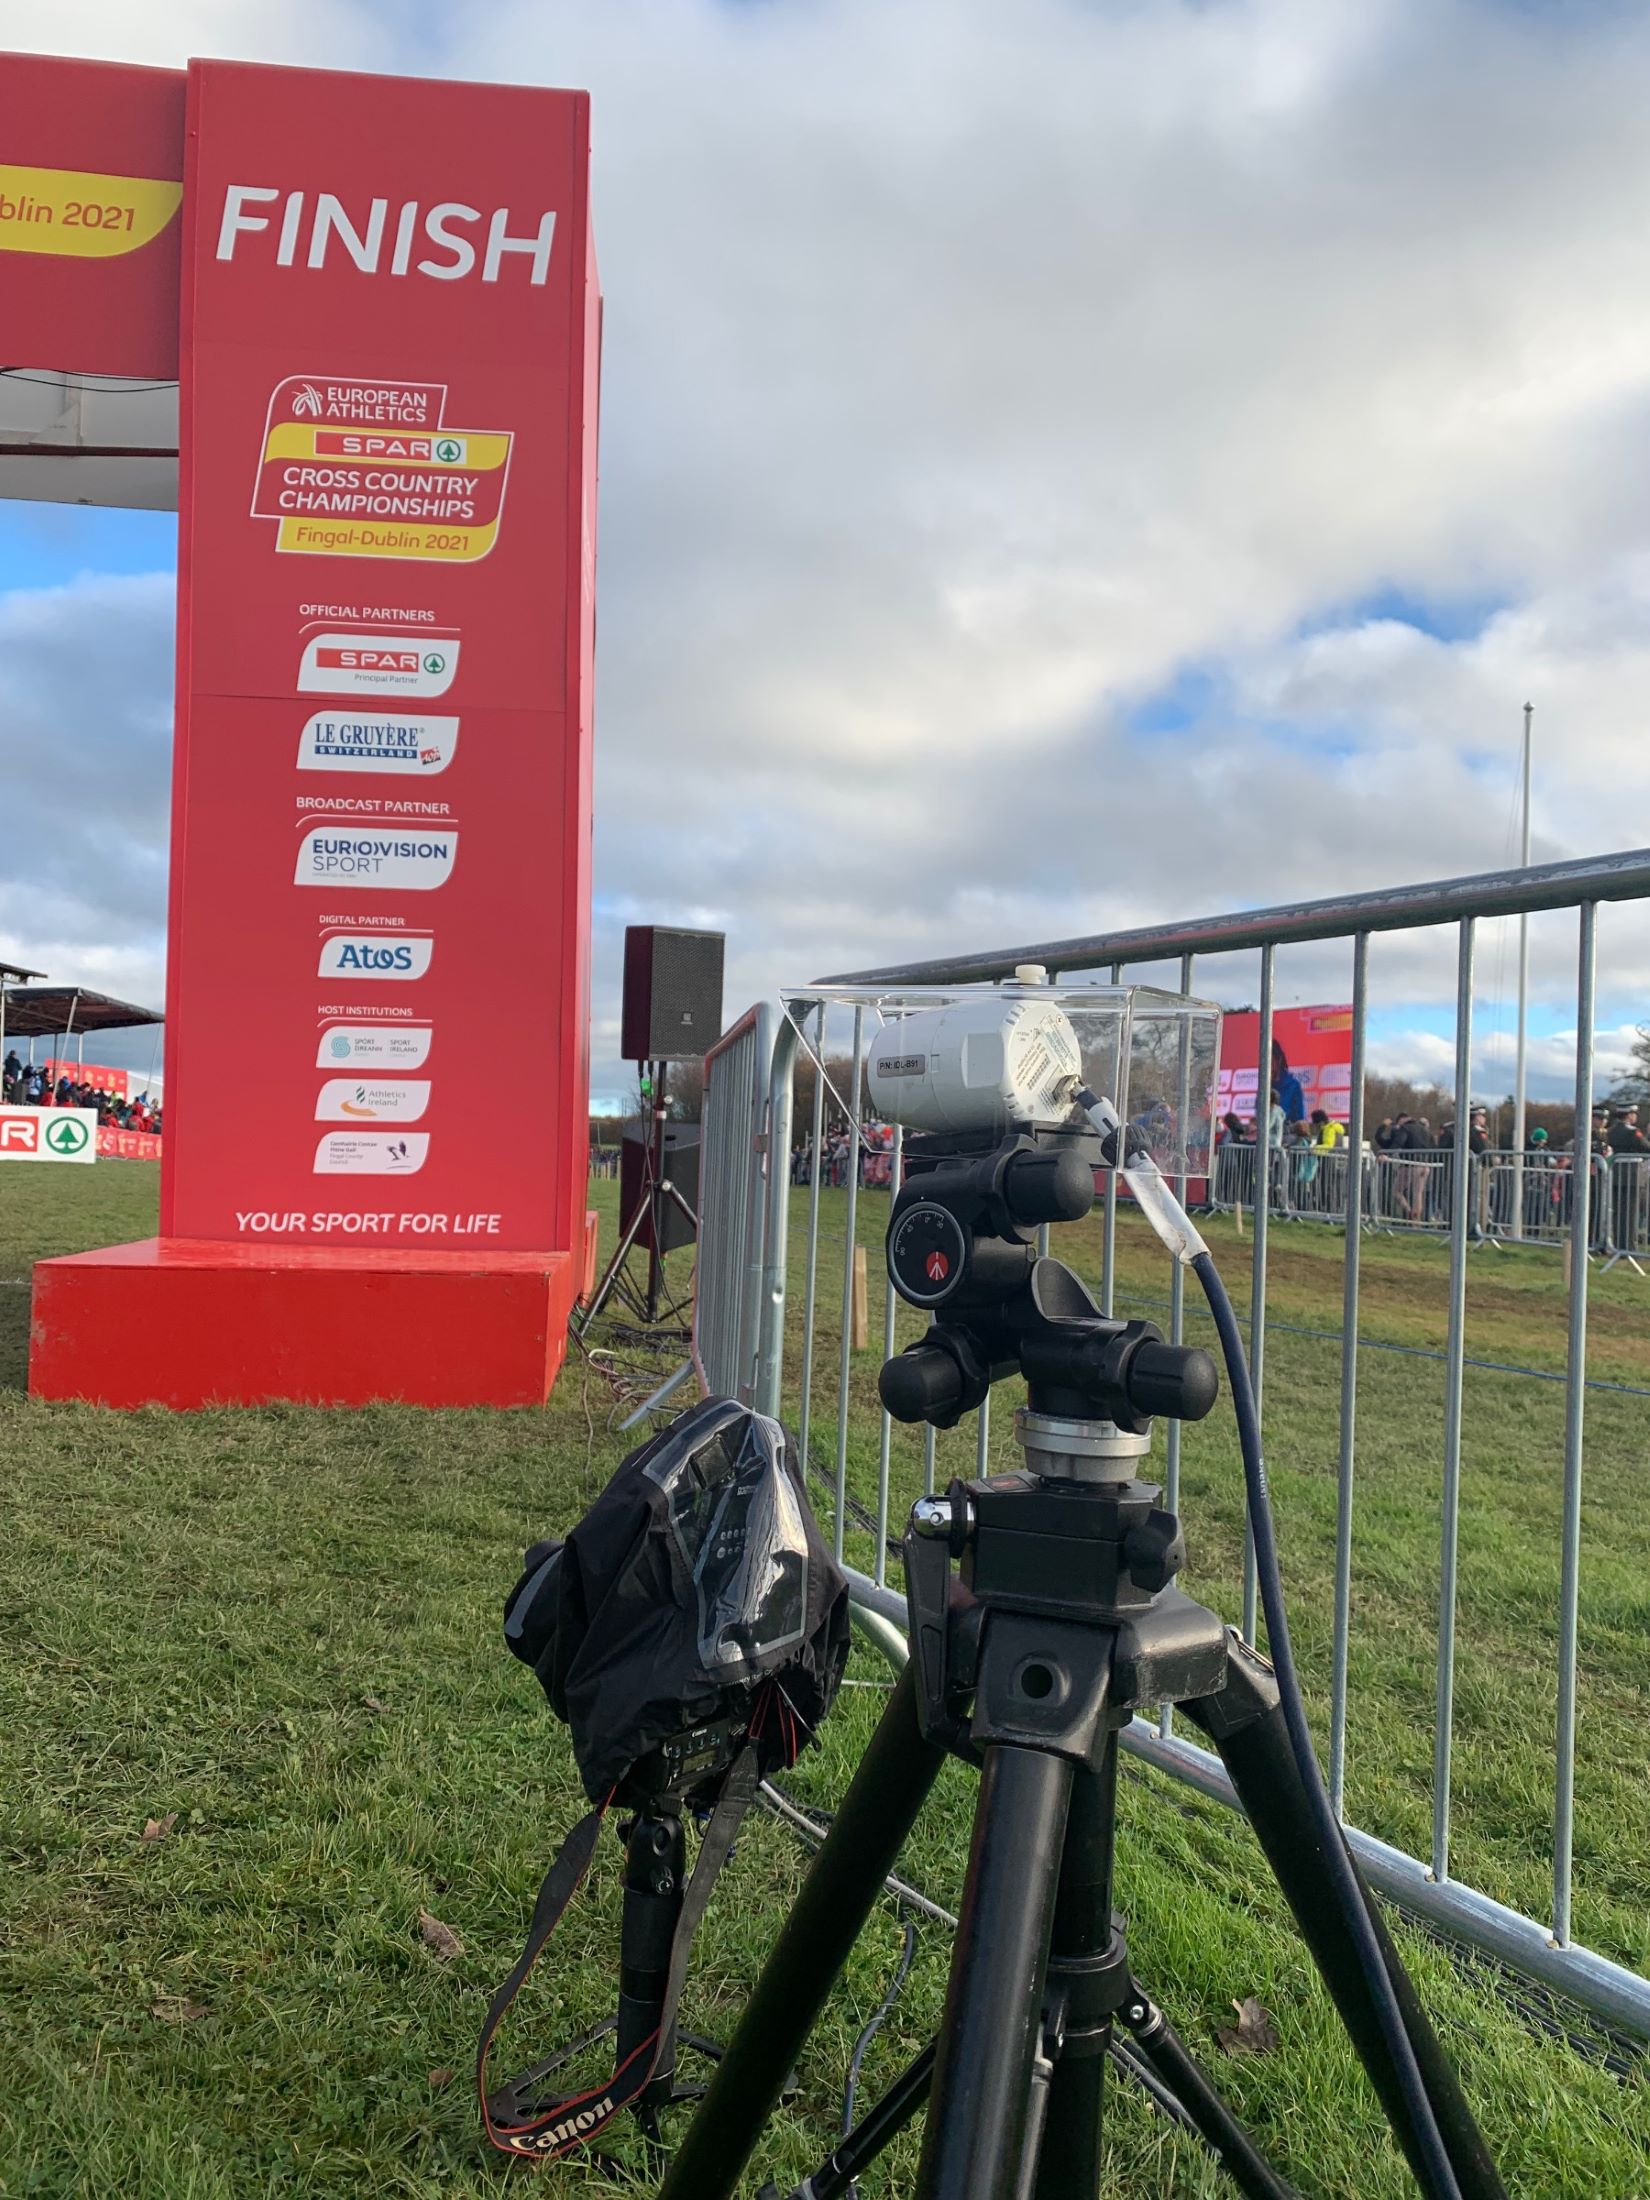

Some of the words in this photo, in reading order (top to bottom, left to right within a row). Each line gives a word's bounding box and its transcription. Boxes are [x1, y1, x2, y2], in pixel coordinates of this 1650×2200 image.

[62, 202, 136, 231] 2021
[215, 184, 558, 287] FINISH
[327, 387, 427, 407] EUROPEAN
[326, 403, 427, 422] ATHLETICS
[342, 437, 430, 457] SPAR
[283, 467, 360, 488] CROSS
[364, 472, 479, 496] COUNTRY
[278, 490, 476, 519] CHAMPIONSHIPS
[296, 526, 420, 548] Fingal-Dublin
[425, 534, 470, 551] 2021
[299, 603, 360, 618] OFFICIAL
[362, 607, 436, 622] PARTNERS
[340, 651, 417, 669] SPAR
[354, 673, 387, 684] Principal
[389, 675, 418, 685] Partner
[315, 723, 335, 743] LE
[340, 722, 419, 747] GRUYÈRE
[318, 746, 413, 758] SWITZERLAND
[296, 796, 381, 811] BROADCAST
[384, 800, 450, 815] PARTNER
[312, 855, 384, 873] SPORT
[319, 914, 357, 925] DIGITAL
[358, 916, 405, 927] PARTNER
[317, 1005, 345, 1015] HOST
[346, 1006, 413, 1016] INSTITUTIONS
[368, 1089, 406, 1098] Athletics
[368, 1099, 398, 1107] Ireland
[235, 1212, 306, 1232] YOUR
[310, 1212, 395, 1233] SPORT
[398, 1213, 448, 1233] FOR
[453, 1214, 501, 1234] LIFE
[509, 2096, 614, 2151] Canon
